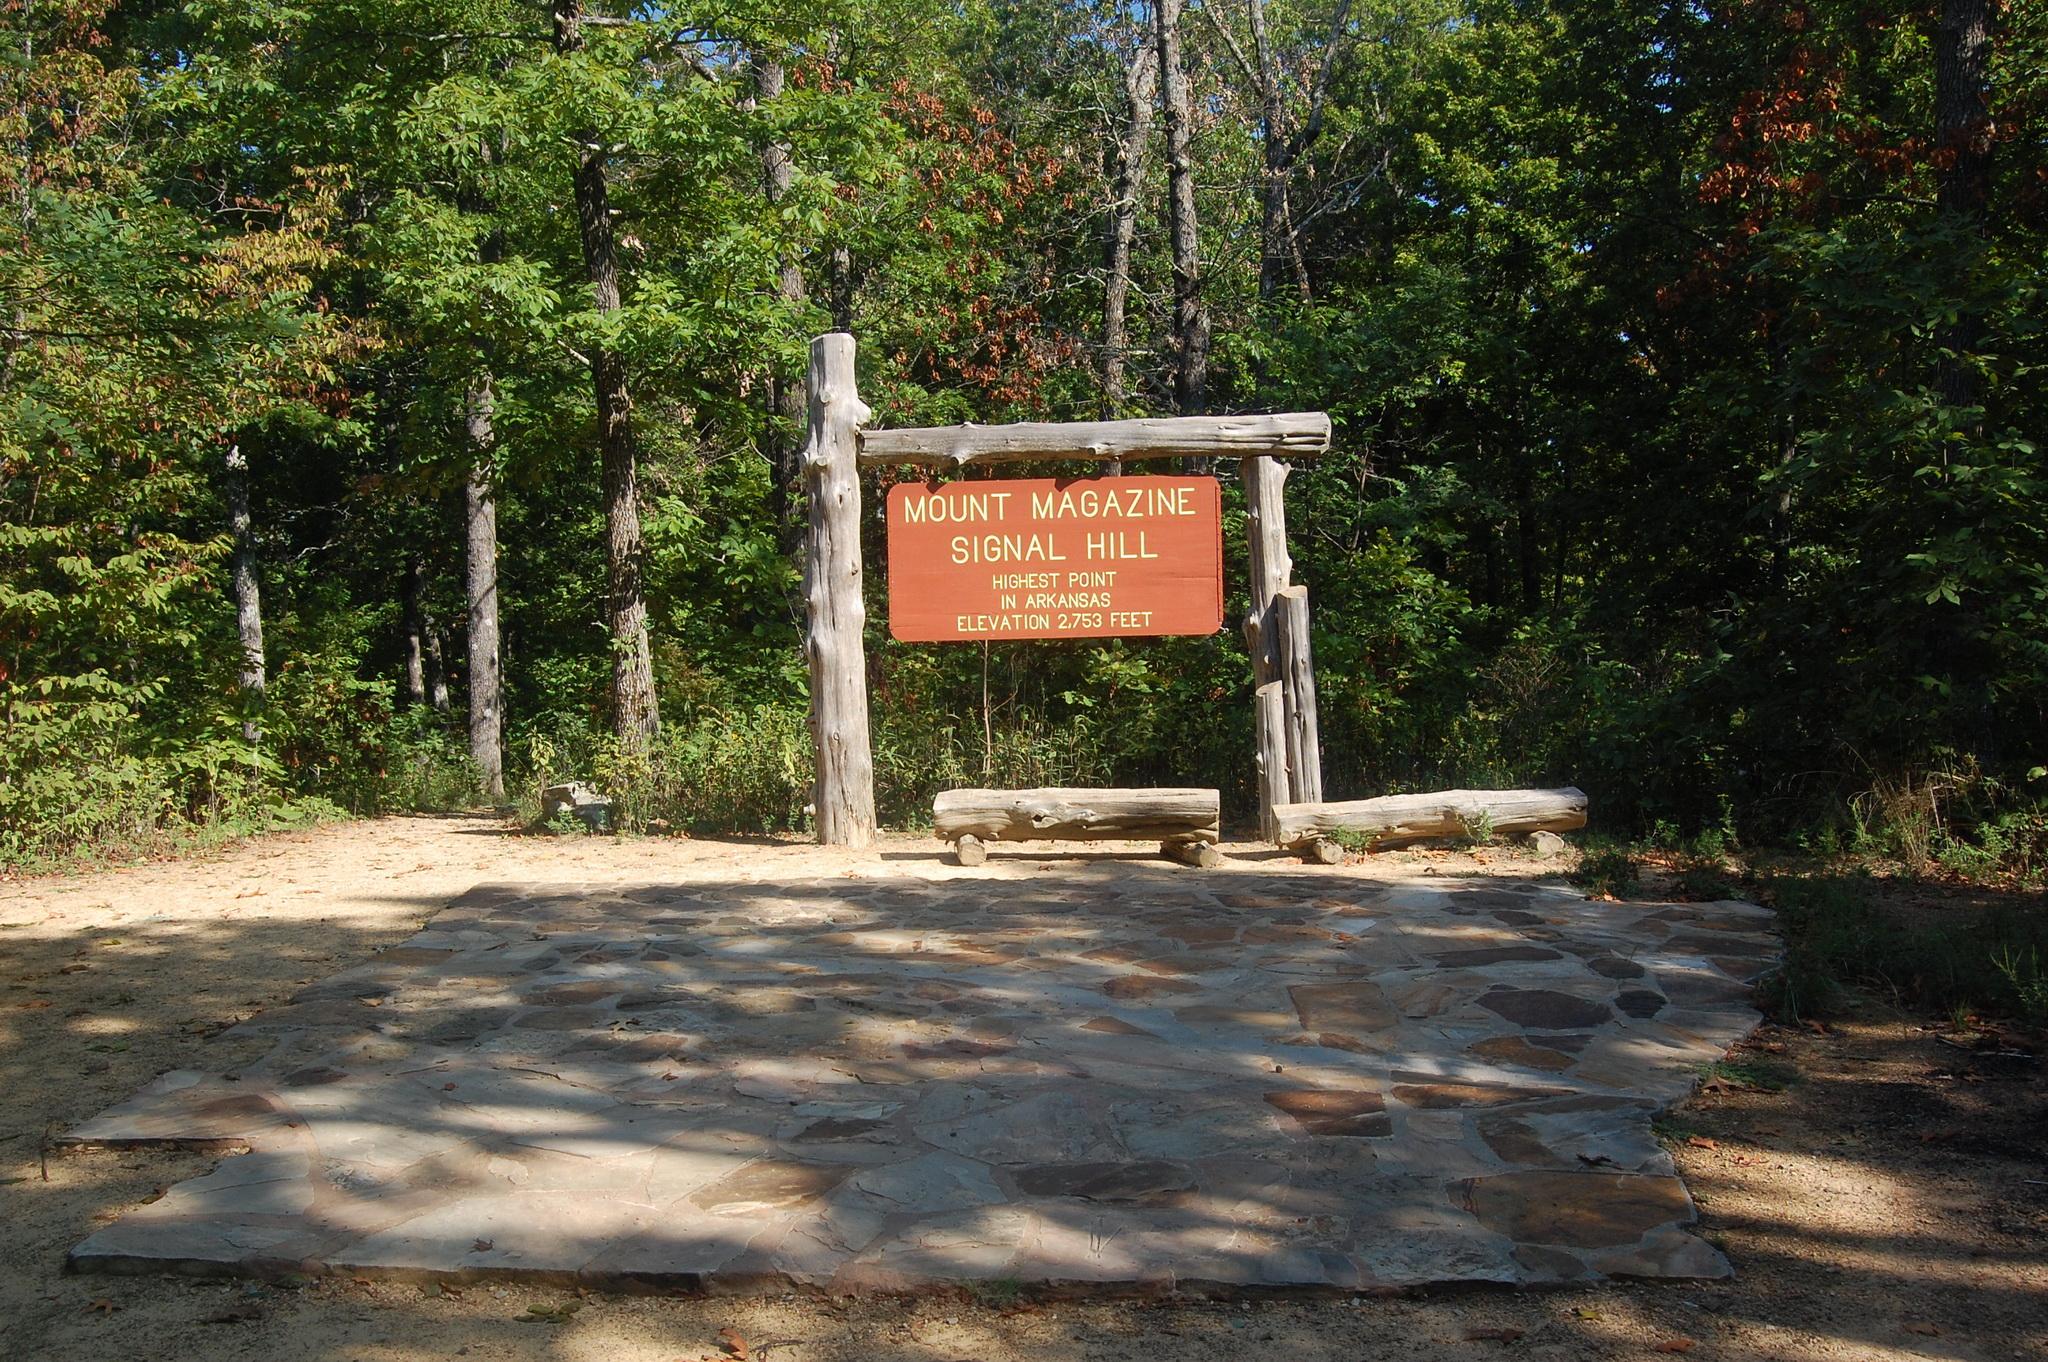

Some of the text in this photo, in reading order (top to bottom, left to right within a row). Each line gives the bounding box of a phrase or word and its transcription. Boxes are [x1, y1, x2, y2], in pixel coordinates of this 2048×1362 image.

[904, 487, 1197, 524] MOUNT MAGAZINE
[951, 530, 1159, 565] SIGNAL HILL
[992, 570, 1118, 591] HIGHEST POINT
[1000, 590, 1112, 611] IN ARKANSAS
[956, 611, 1153, 632] ELEVATION 2,753 FEET
